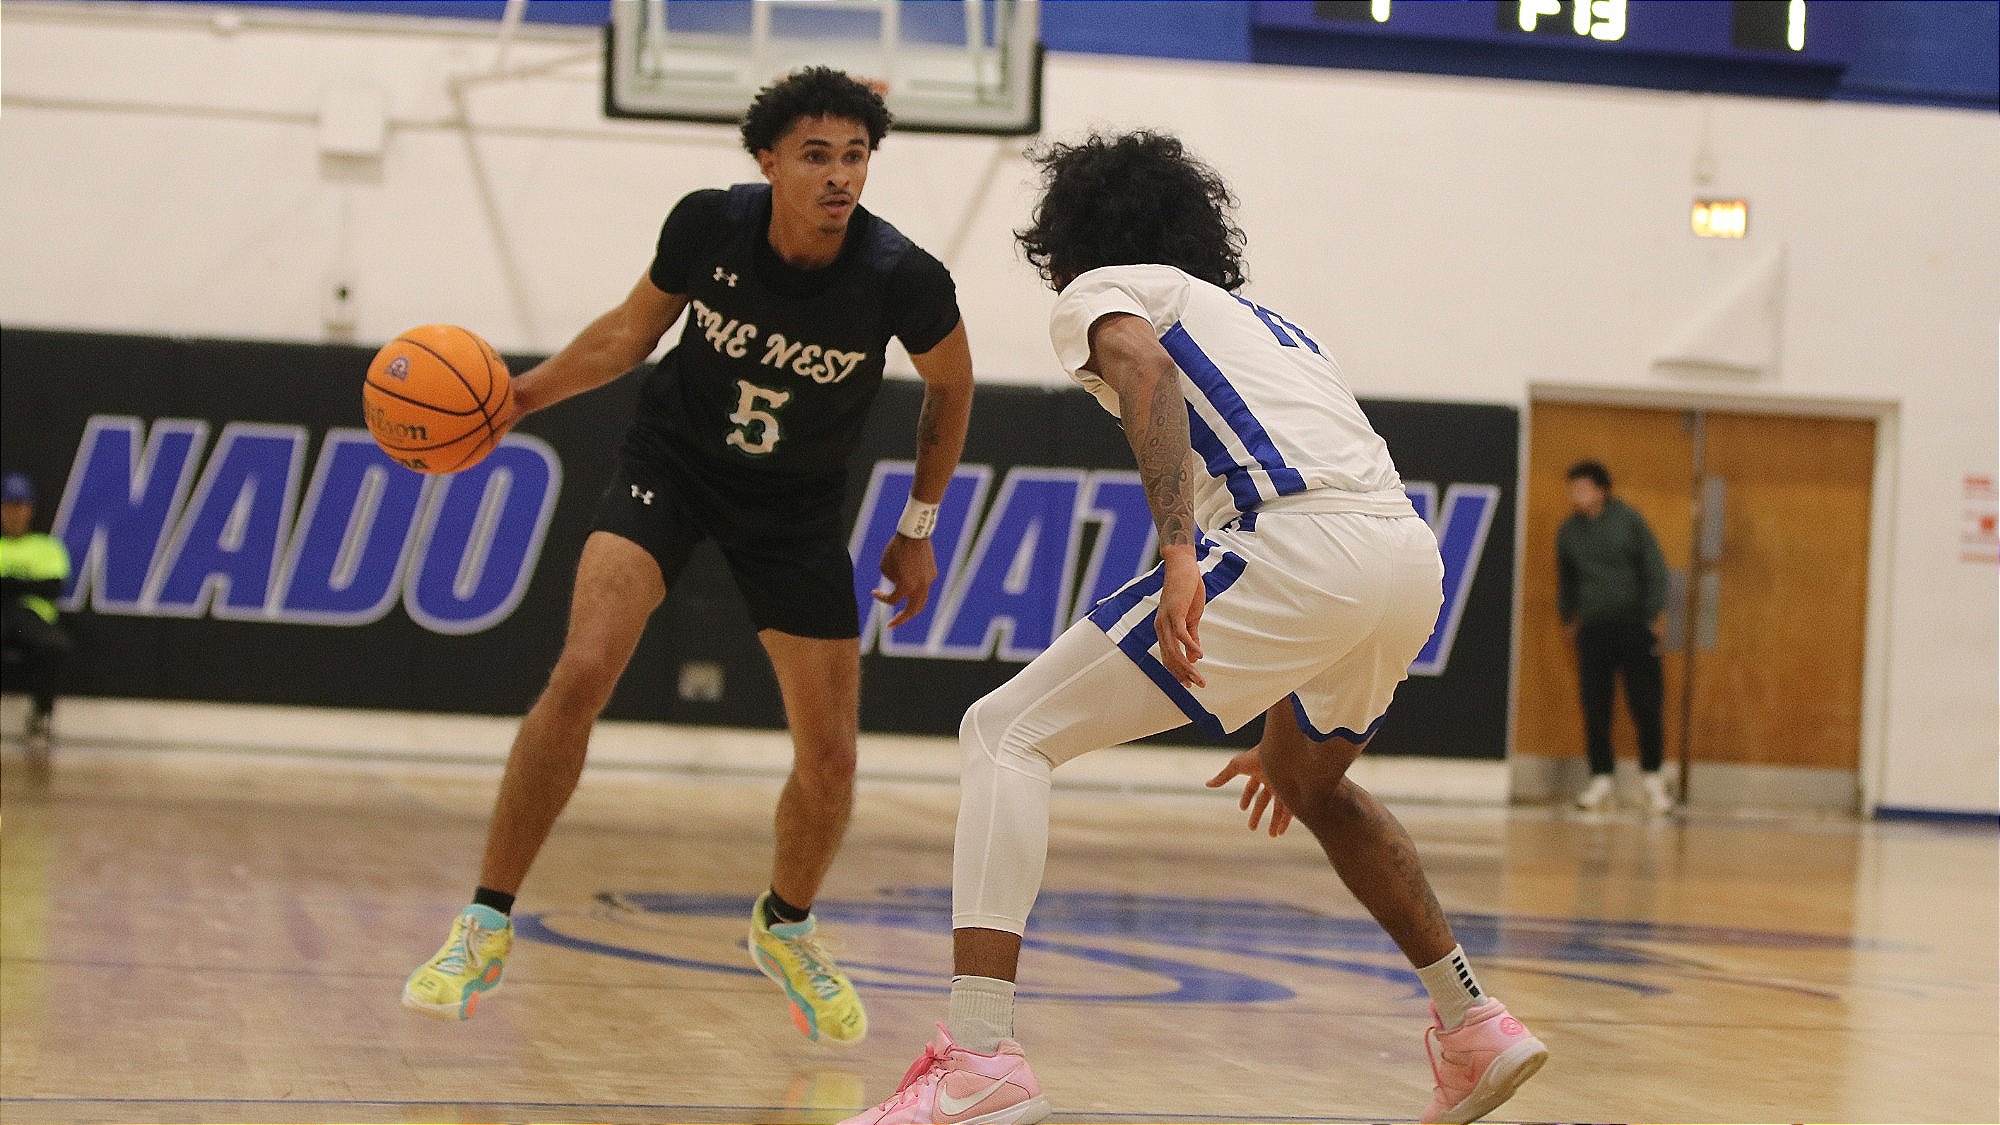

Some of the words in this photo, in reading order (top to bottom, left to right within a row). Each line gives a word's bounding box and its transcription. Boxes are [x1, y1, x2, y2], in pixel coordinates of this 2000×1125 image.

[692, 299, 758, 359] THE
[760, 332, 867, 384] NEST
[725, 378, 790, 454] 5
[50, 413, 565, 636] NADO
